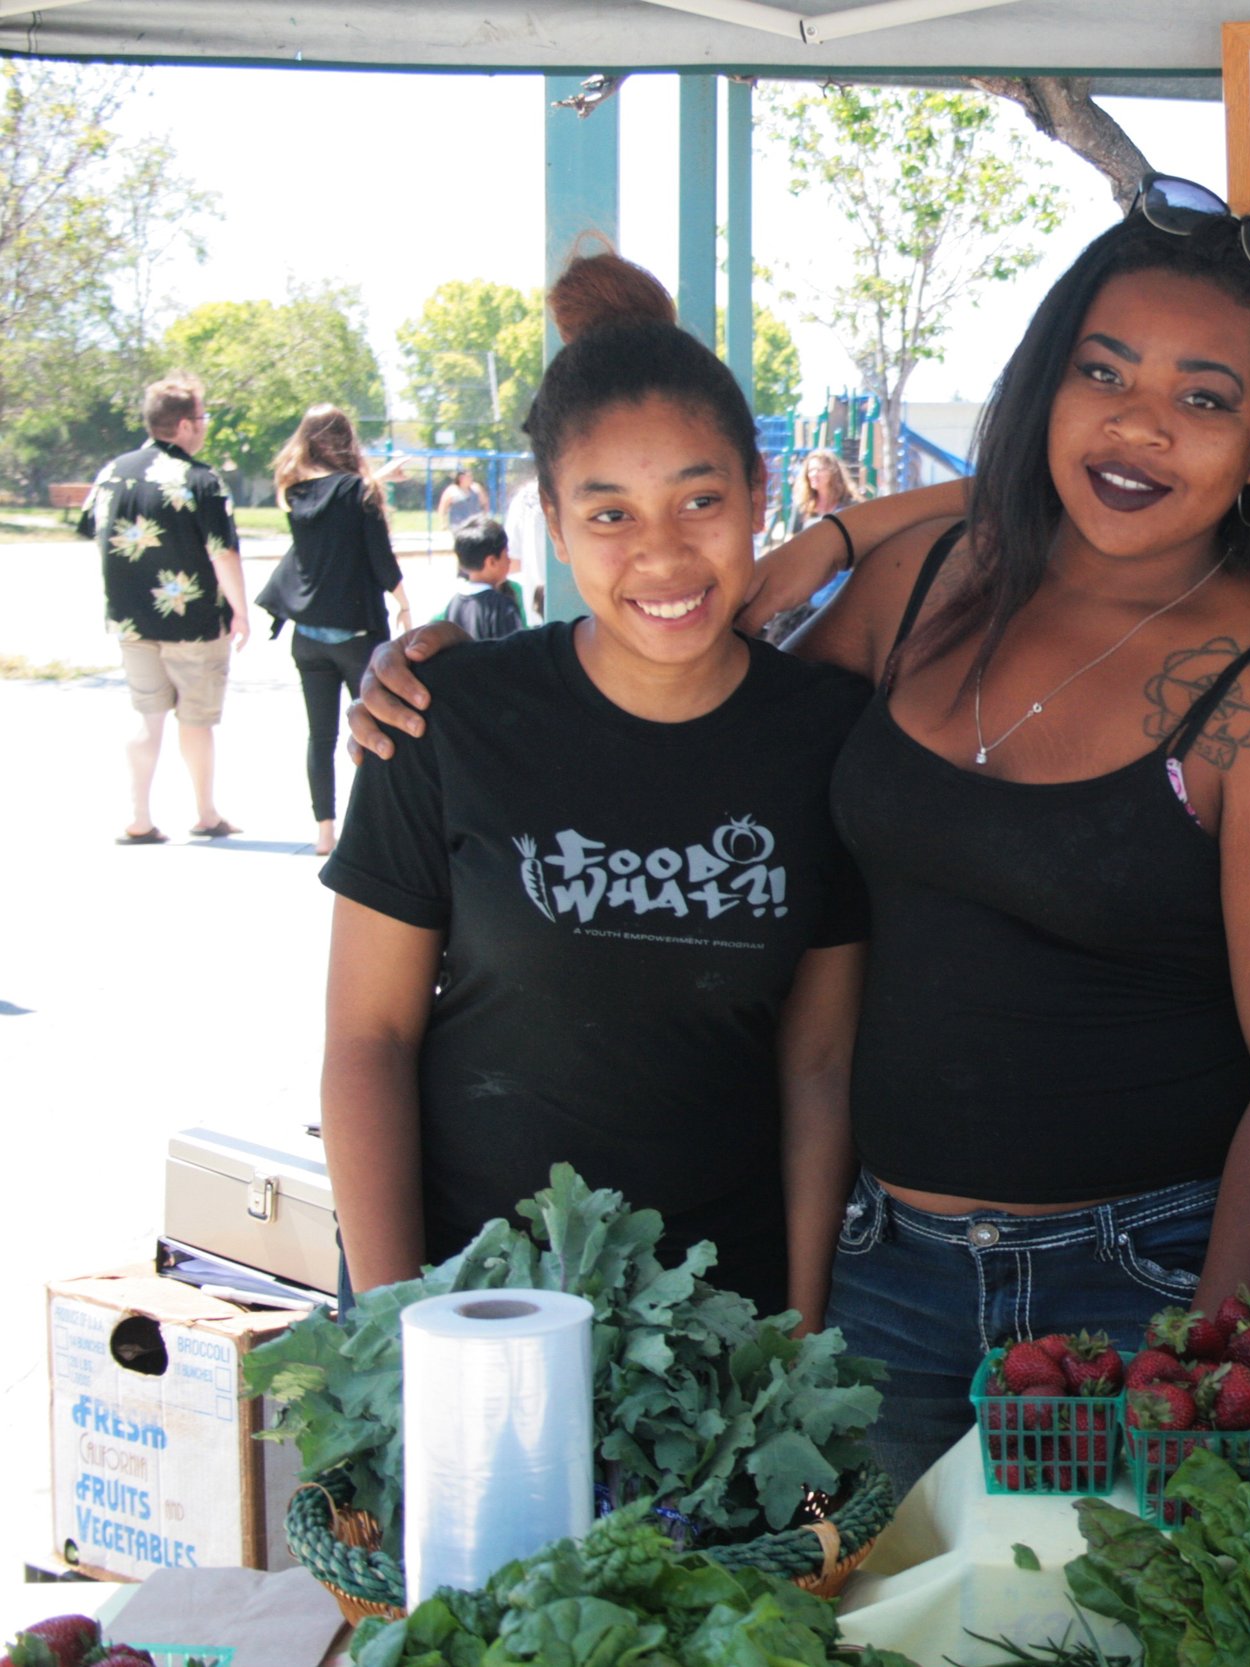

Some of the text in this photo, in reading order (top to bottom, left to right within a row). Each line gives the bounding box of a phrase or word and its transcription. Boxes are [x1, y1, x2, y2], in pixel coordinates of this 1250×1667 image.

[585, 928, 621, 938] YOUTH
[623, 931, 709, 946] EMPOWERMENT
[712, 939, 765, 950] PROGRAM
[177, 1335, 230, 1364] BROCCOLI
[72, 1393, 169, 1451] FRESH
[79, 1431, 149, 1483] CALIFORNIA
[75, 1472, 153, 1521] FRUITS
[75, 1504, 199, 1569] VEGETABLES
